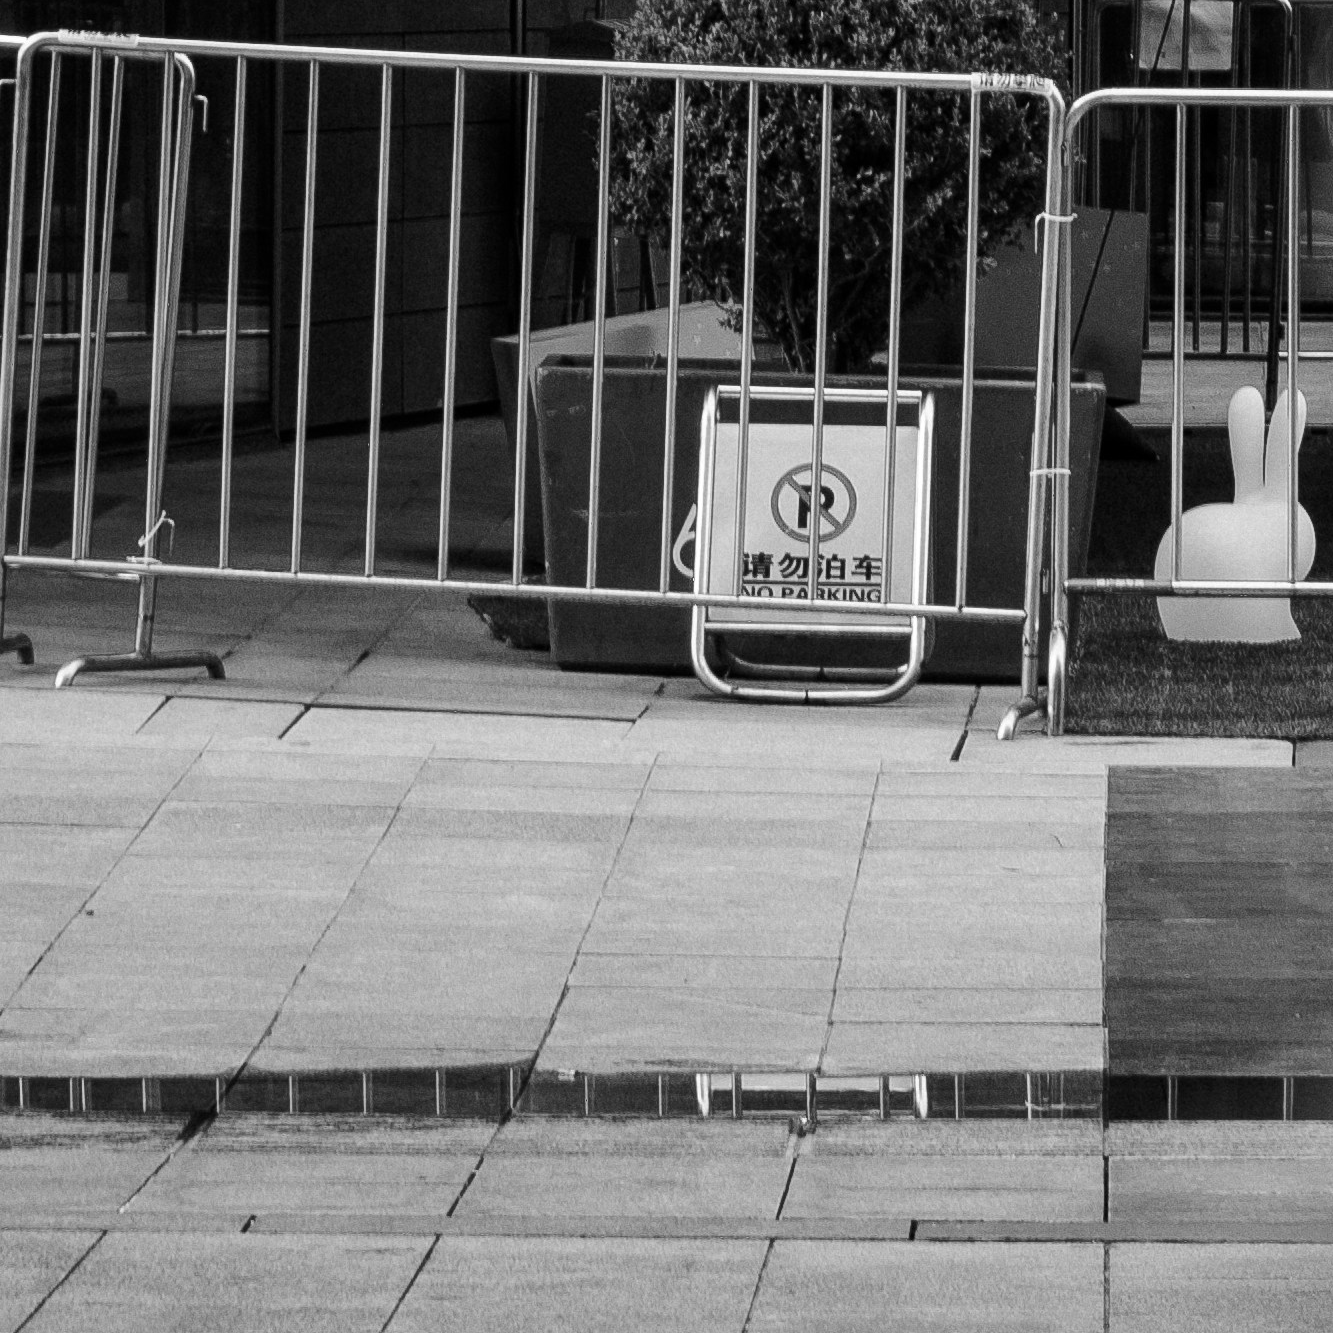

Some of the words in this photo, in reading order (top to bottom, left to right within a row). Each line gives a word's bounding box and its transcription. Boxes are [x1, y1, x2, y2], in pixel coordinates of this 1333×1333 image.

[742, 552, 882, 581] 请勿泊车
[740, 585, 774, 598] NO
[781, 586, 882, 603] PARKING
